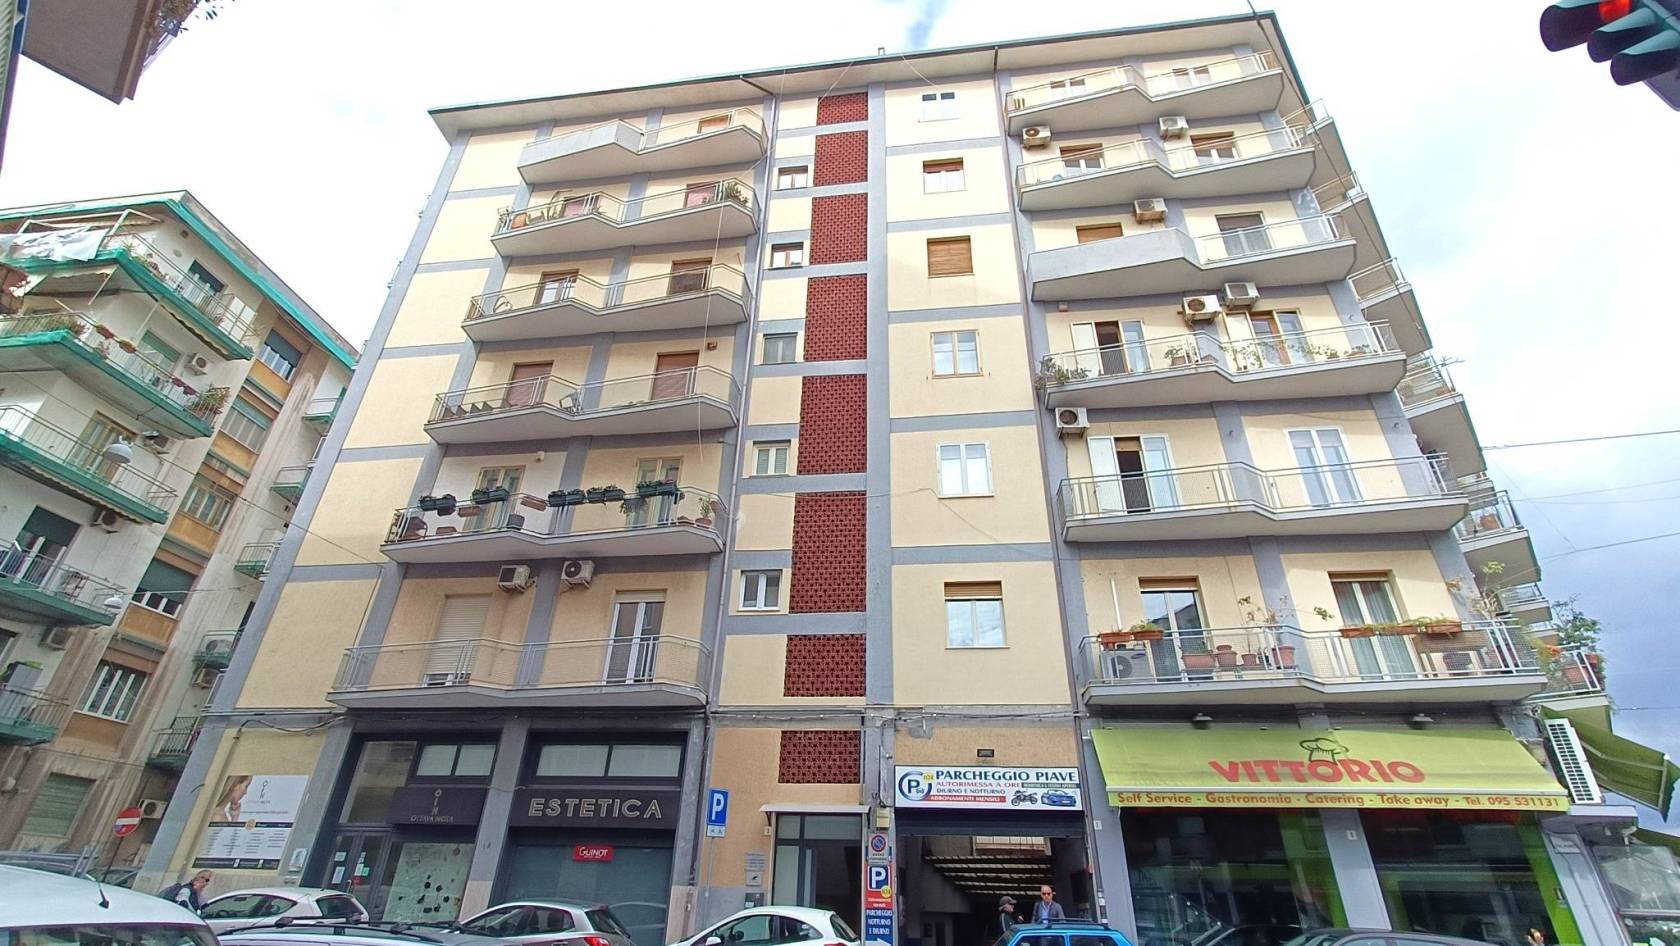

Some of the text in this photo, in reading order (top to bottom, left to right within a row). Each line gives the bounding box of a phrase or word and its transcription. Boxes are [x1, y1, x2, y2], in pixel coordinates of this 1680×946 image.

[935, 770, 1076, 781] PARCHEGGIO PIAVE
[1208, 758, 1425, 783] VITTORIO
[528, 798, 662, 818] ESTETICA
[712, 793, 724, 820] P
[1117, 792, 1142, 804] Self
[1146, 792, 1192, 804] Service
[1205, 792, 1292, 804] Gastronomia
[1305, 793, 1364, 806] Catering
[1377, 793, 1411, 805] Take
[1414, 796, 1449, 807] away
[1487, 796, 1511, 806] 095
[1514, 797, 1559, 807] 531131
[871, 867, 887, 888] P
